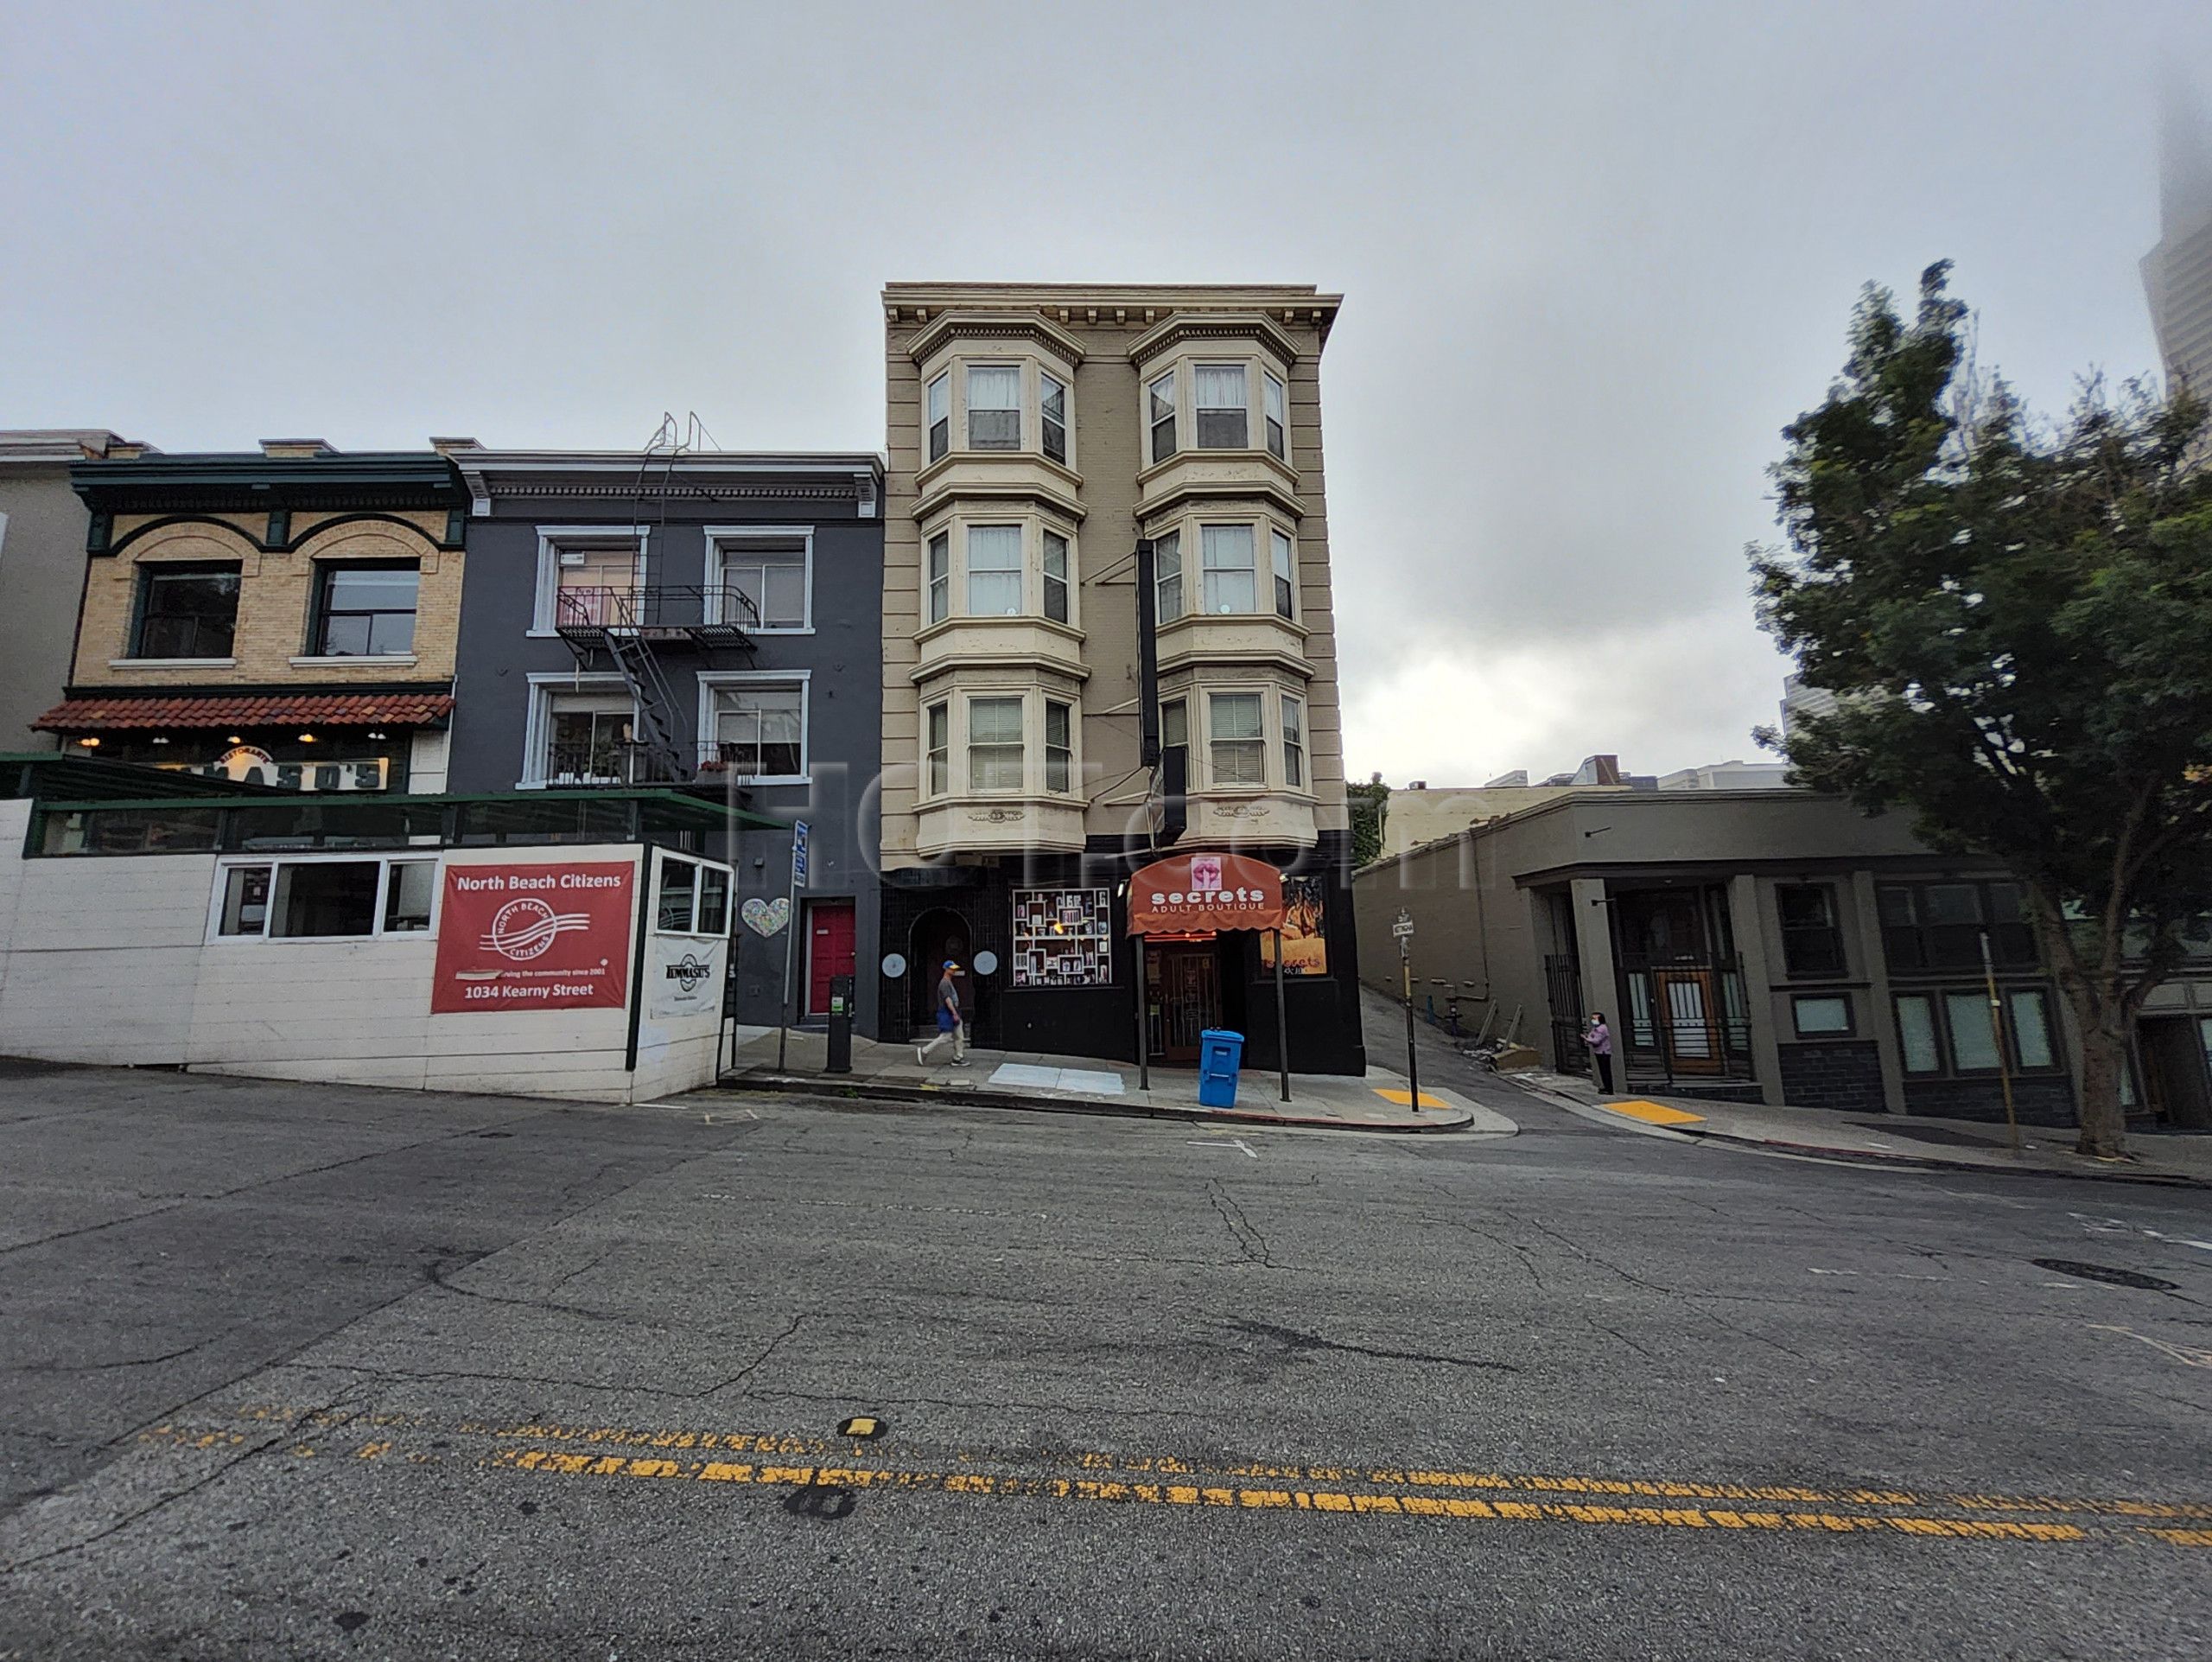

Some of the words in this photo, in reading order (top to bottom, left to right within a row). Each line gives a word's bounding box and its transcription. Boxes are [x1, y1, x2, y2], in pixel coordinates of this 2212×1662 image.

[457, 876, 505, 890] North
[509, 875, 556, 889] Beach
[560, 874, 621, 888] Citizens
[1151, 887, 1265, 905] secrets
[1152, 905, 1192, 914] ADULT
[1198, 902, 1265, 912] BOUTIQUE
[497, 905, 519, 934] NORTH
[521, 902, 549, 919] BEACH
[510, 935, 550, 957] CITIZENS
[1265, 957, 1320, 968] screts
[534, 969, 571, 977] community
[465, 985, 499, 999] 1034
[502, 984, 550, 999] Kearny
[552, 983, 594, 997] Street
